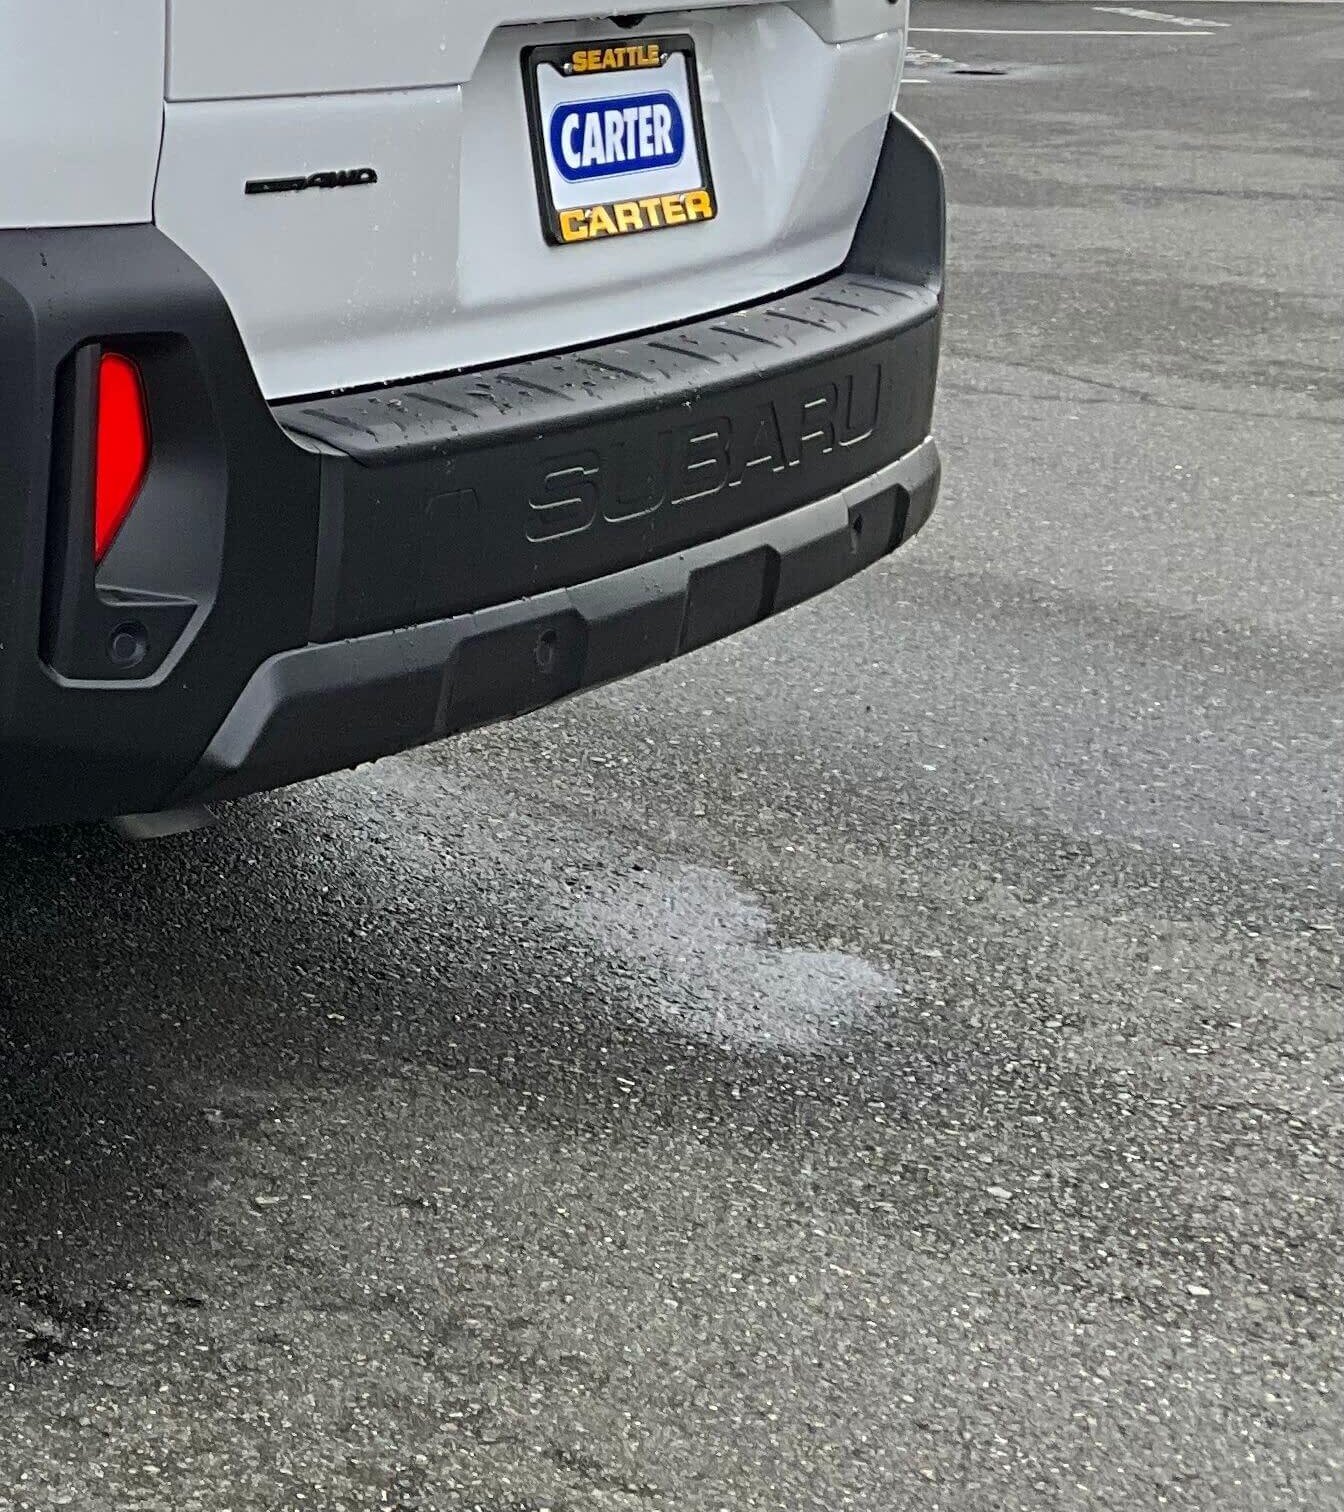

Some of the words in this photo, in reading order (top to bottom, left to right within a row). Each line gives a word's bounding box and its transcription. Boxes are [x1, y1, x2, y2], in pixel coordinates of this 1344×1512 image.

[571, 44, 660, 73] SEATTLE
[560, 102, 675, 170] CARTER
[558, 189, 714, 243] CARTER
[525, 362, 883, 544] SUBARU
